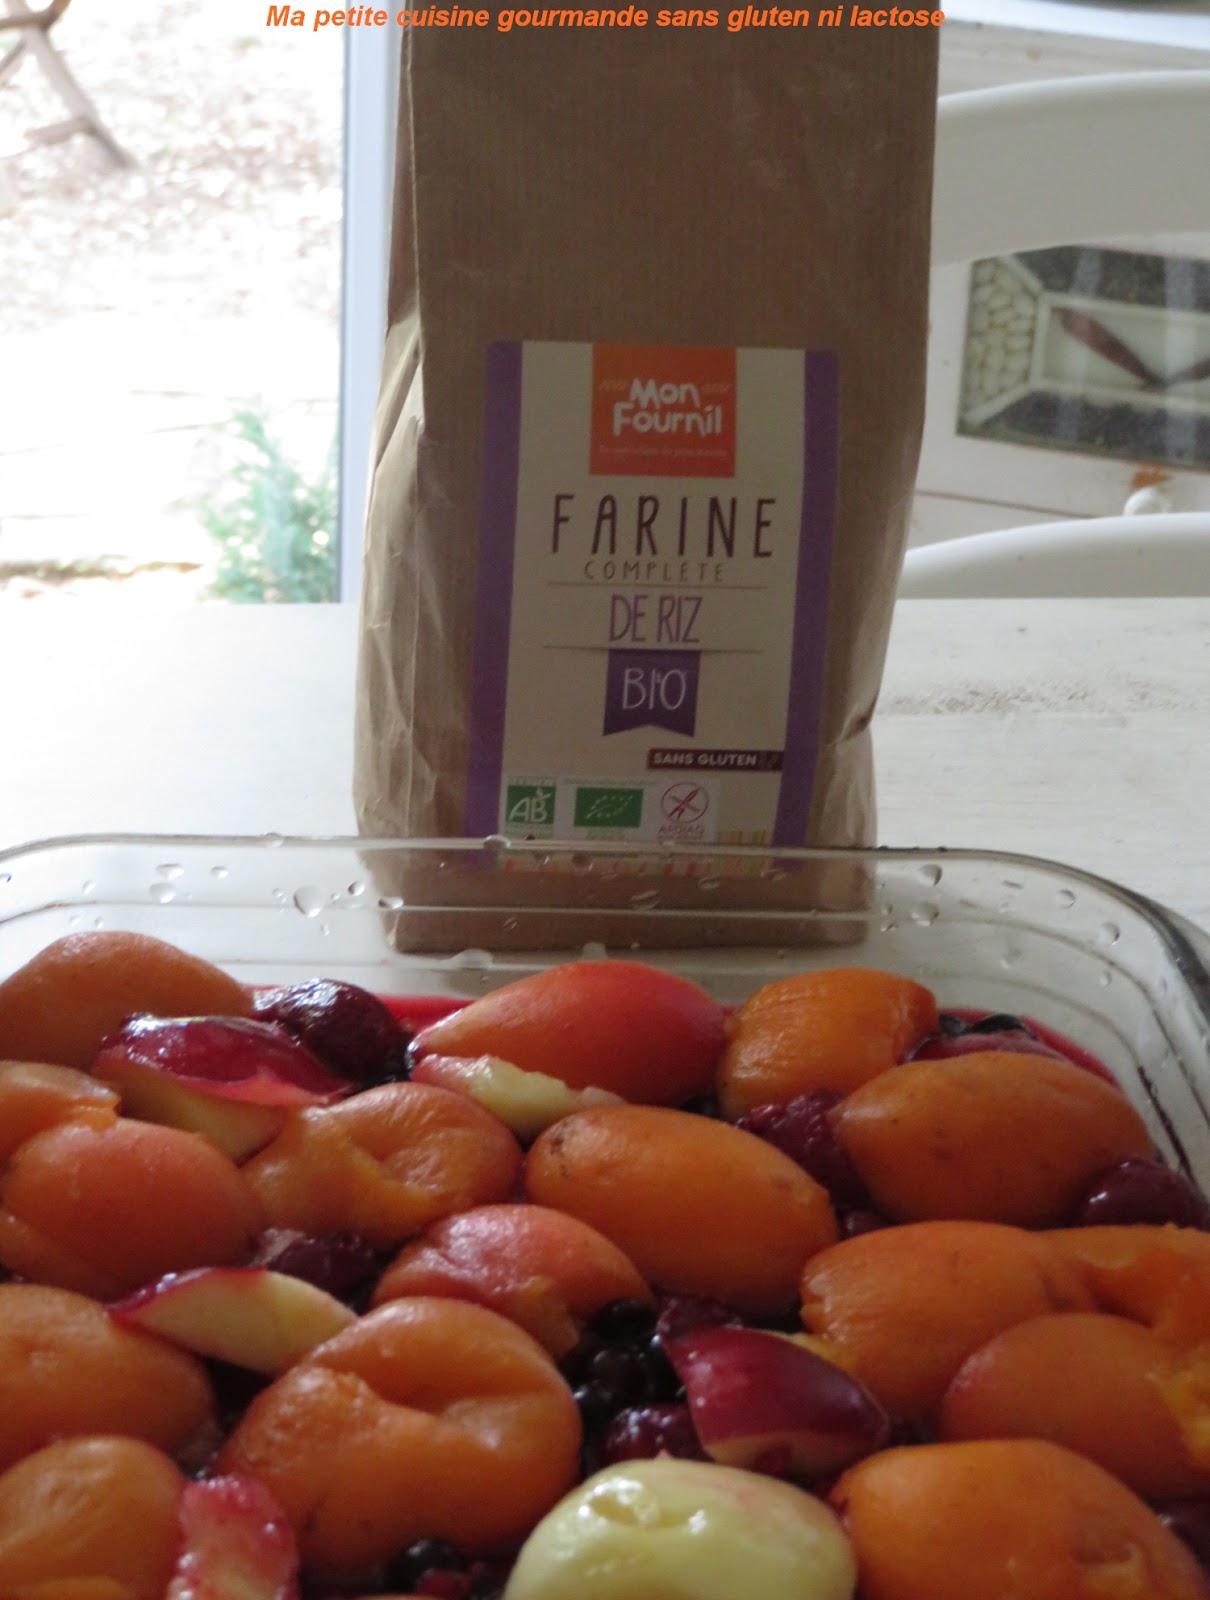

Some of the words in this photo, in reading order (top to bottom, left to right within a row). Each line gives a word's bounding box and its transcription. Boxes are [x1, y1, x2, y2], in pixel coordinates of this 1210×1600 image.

[629, 377, 701, 407] Mon
[612, 401, 722, 437] Fournil
[552, 493, 776, 558] FARINE
[609, 593, 649, 642] DE
[656, 595, 703, 643] RIZ
[622, 667, 686, 710] BIO
[653, 752, 694, 765] SANS
[697, 753, 757, 767] GLUTEN
